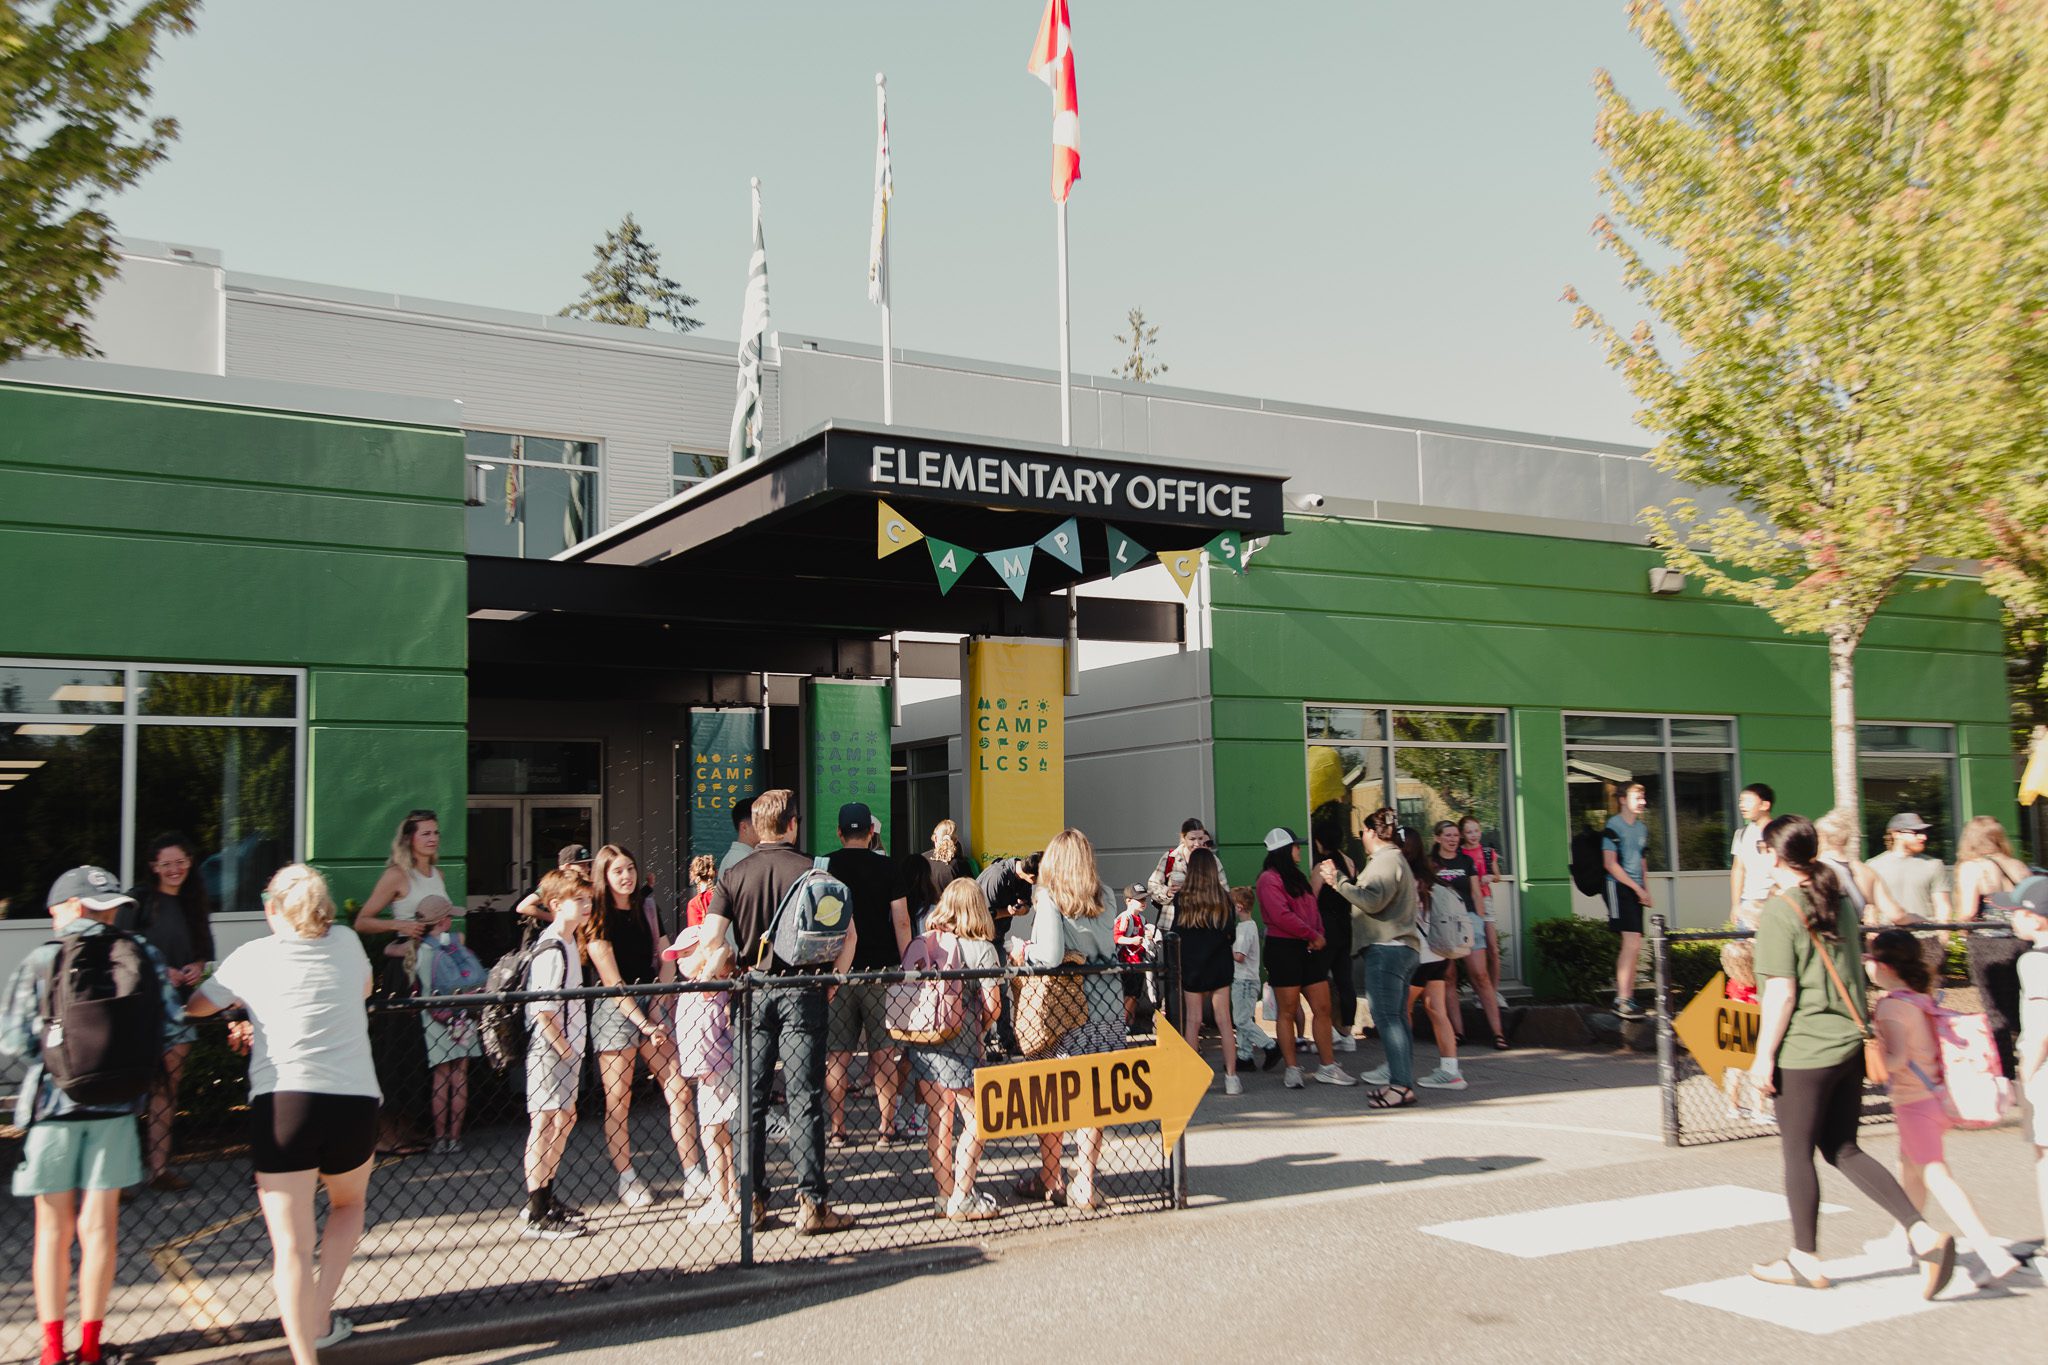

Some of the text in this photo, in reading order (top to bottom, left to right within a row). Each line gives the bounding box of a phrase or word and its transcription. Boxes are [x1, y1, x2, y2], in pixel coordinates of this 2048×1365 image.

[872, 446, 1251, 519] ELEMENTARY OFFICE
[978, 716, 1048, 733] CAMP
[980, 755, 1029, 772] LCS
[696, 767, 753, 780] CAMP
[697, 796, 737, 809] LCS
[981, 1059, 1153, 1133] CAMP LCS
